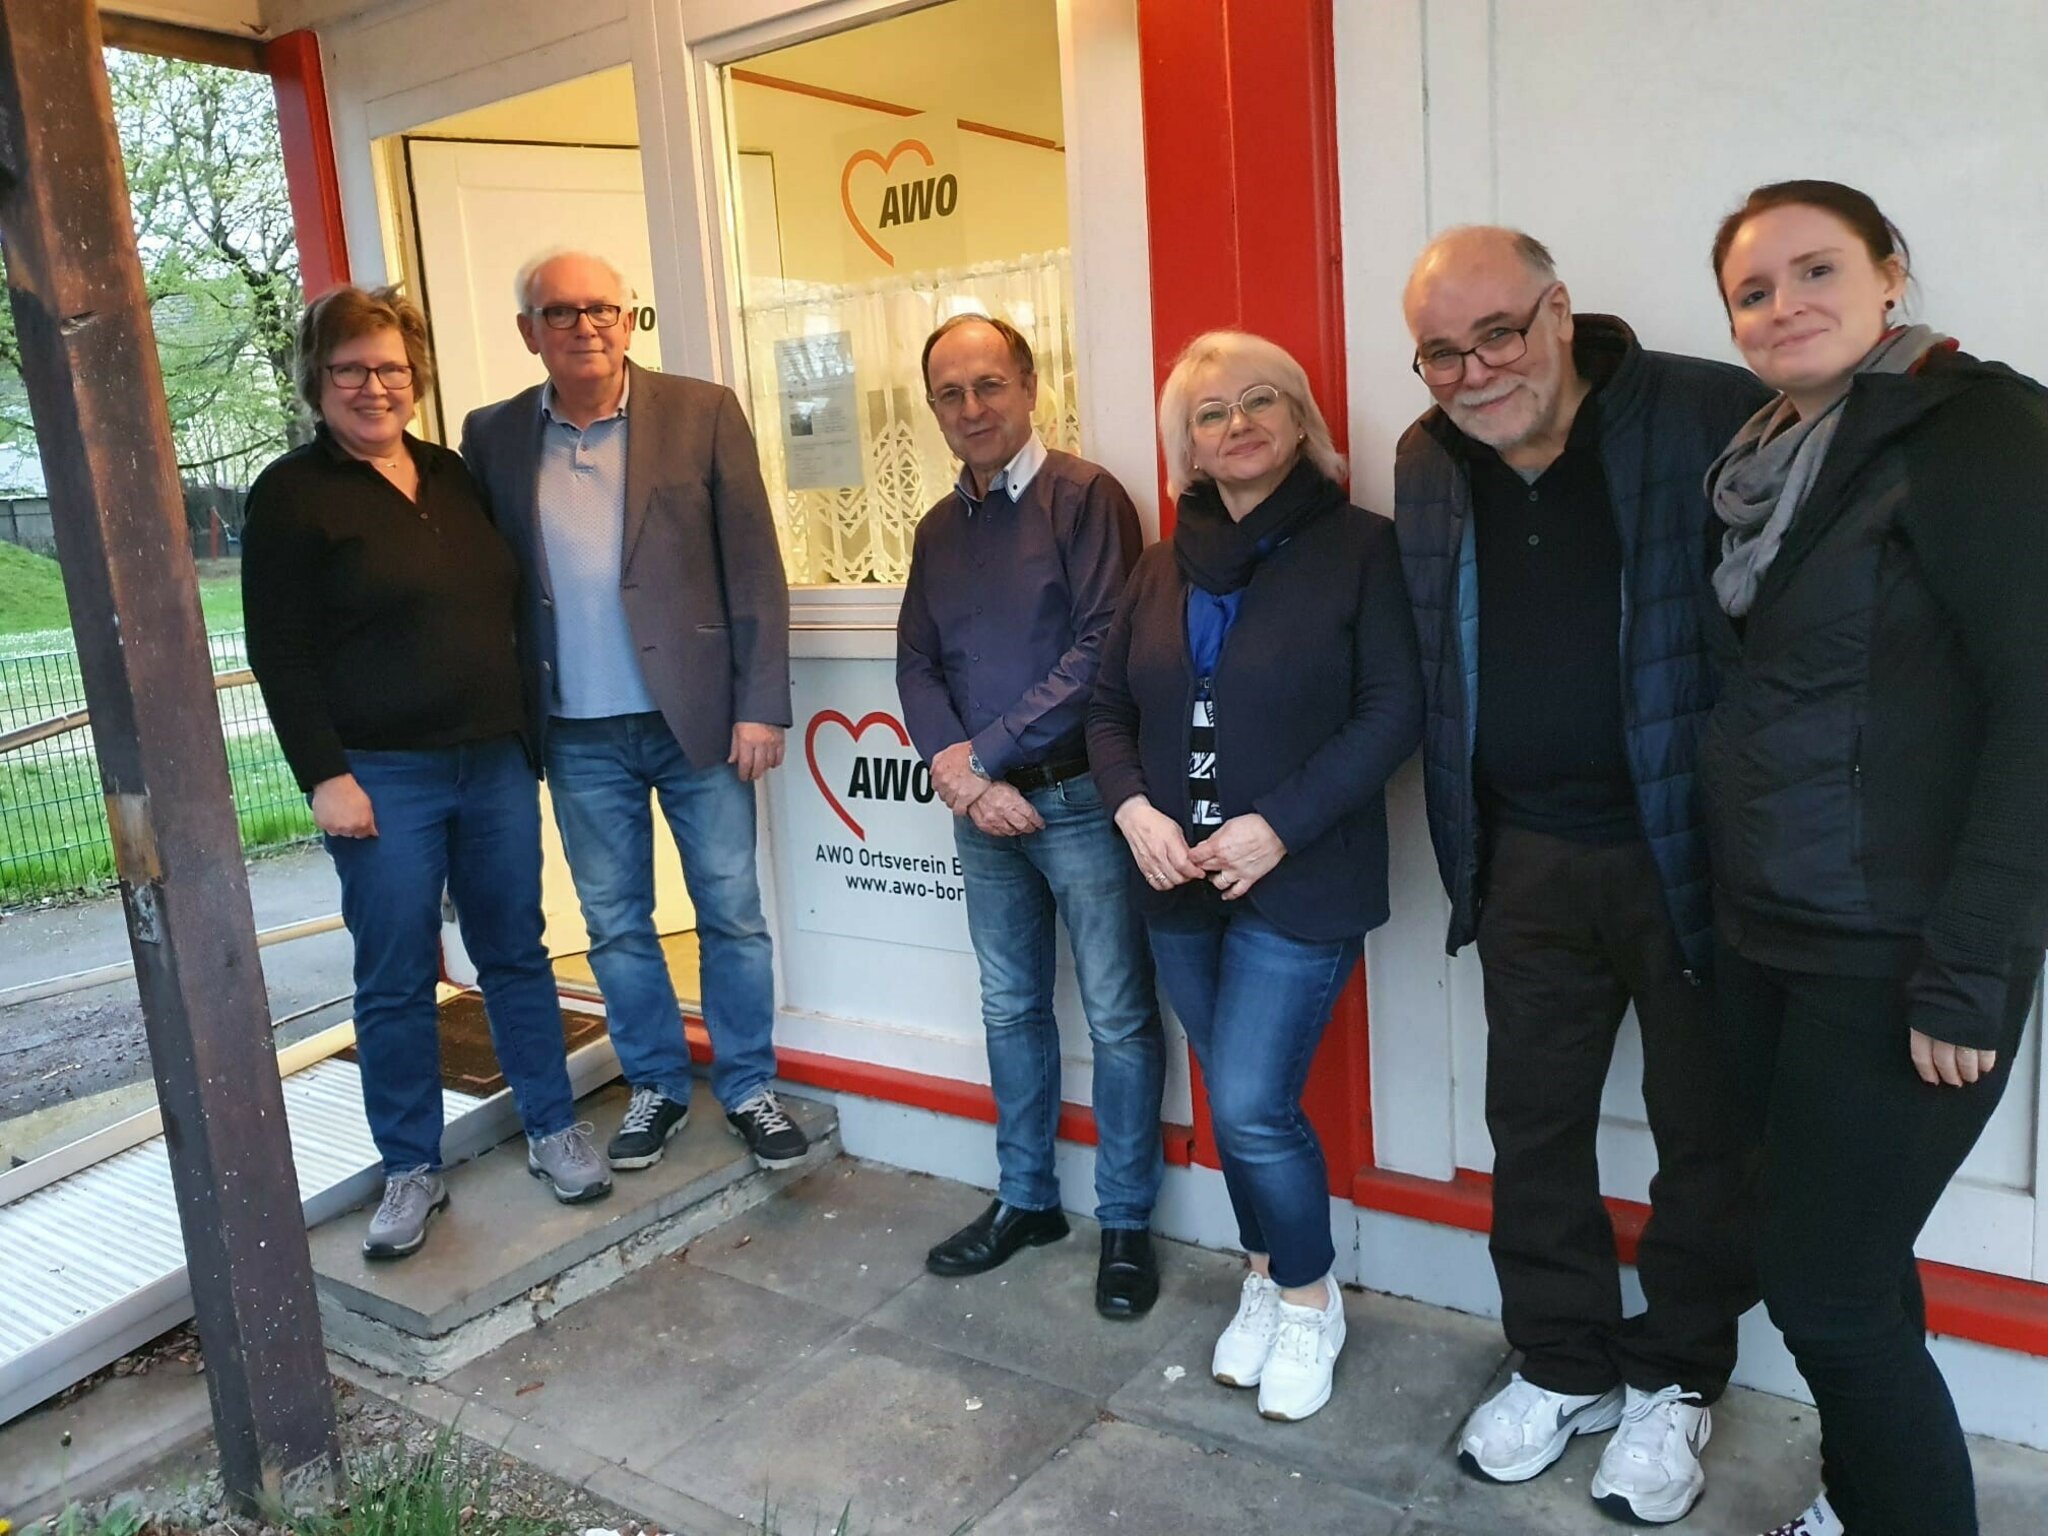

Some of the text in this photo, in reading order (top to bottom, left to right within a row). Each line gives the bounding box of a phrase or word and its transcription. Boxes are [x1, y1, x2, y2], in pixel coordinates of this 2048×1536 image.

[879, 173, 958, 229] AWO
[848, 757, 935, 803] AWO
[816, 844, 853, 865] AWO
[859, 848, 946, 875] Ortsverein
